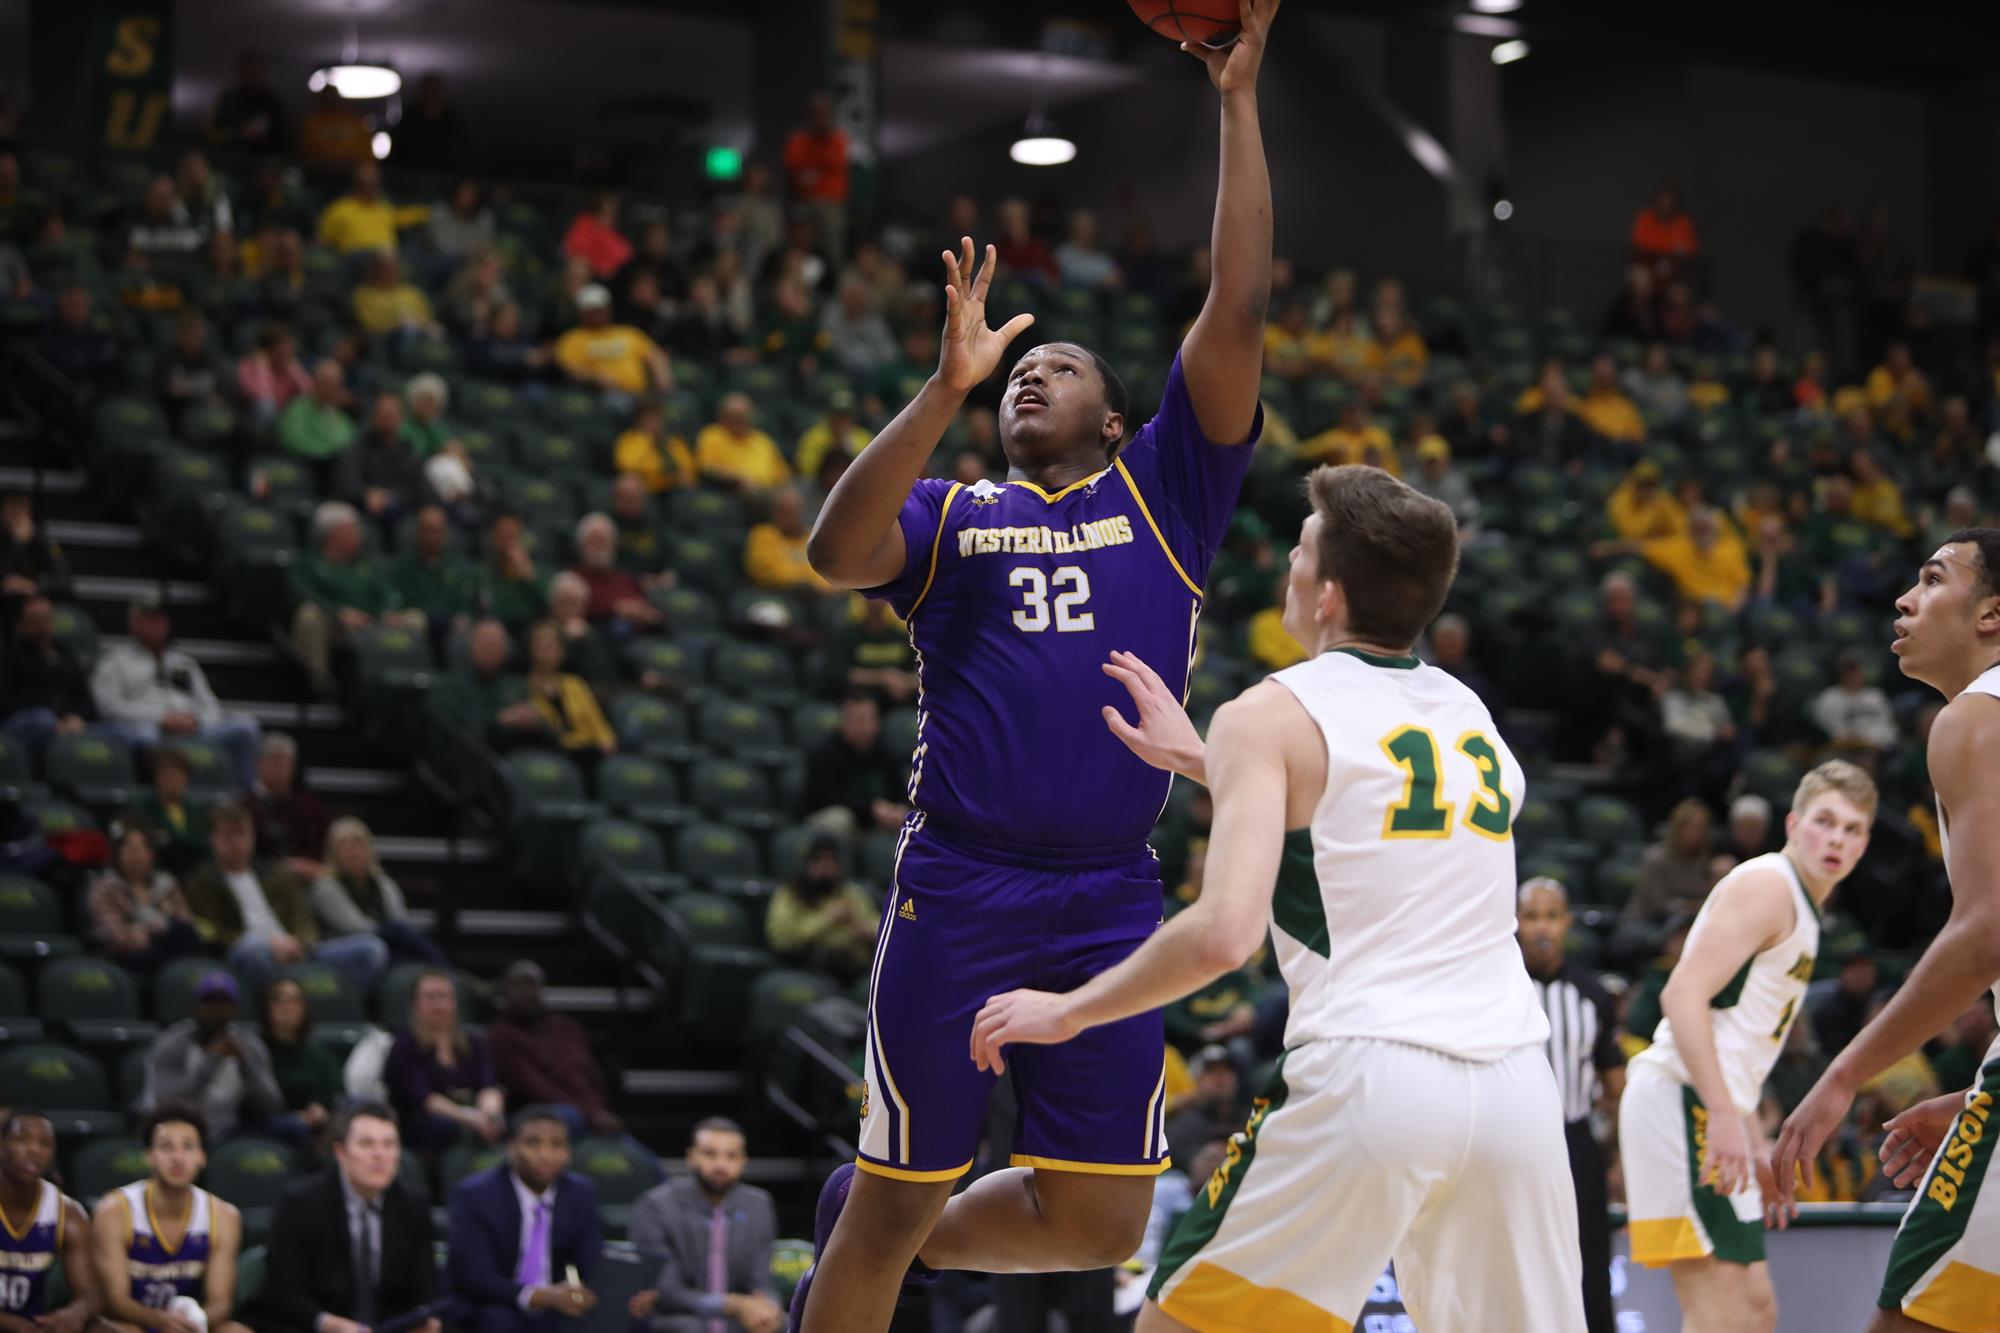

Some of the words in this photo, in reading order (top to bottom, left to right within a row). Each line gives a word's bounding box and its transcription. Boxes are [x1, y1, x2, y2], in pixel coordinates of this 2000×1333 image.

[957, 525, 1054, 558] WESTERN
[1008, 565, 1095, 632] 32
[1378, 723, 1512, 843] 13
[1927, 1091, 1993, 1212] BISON
